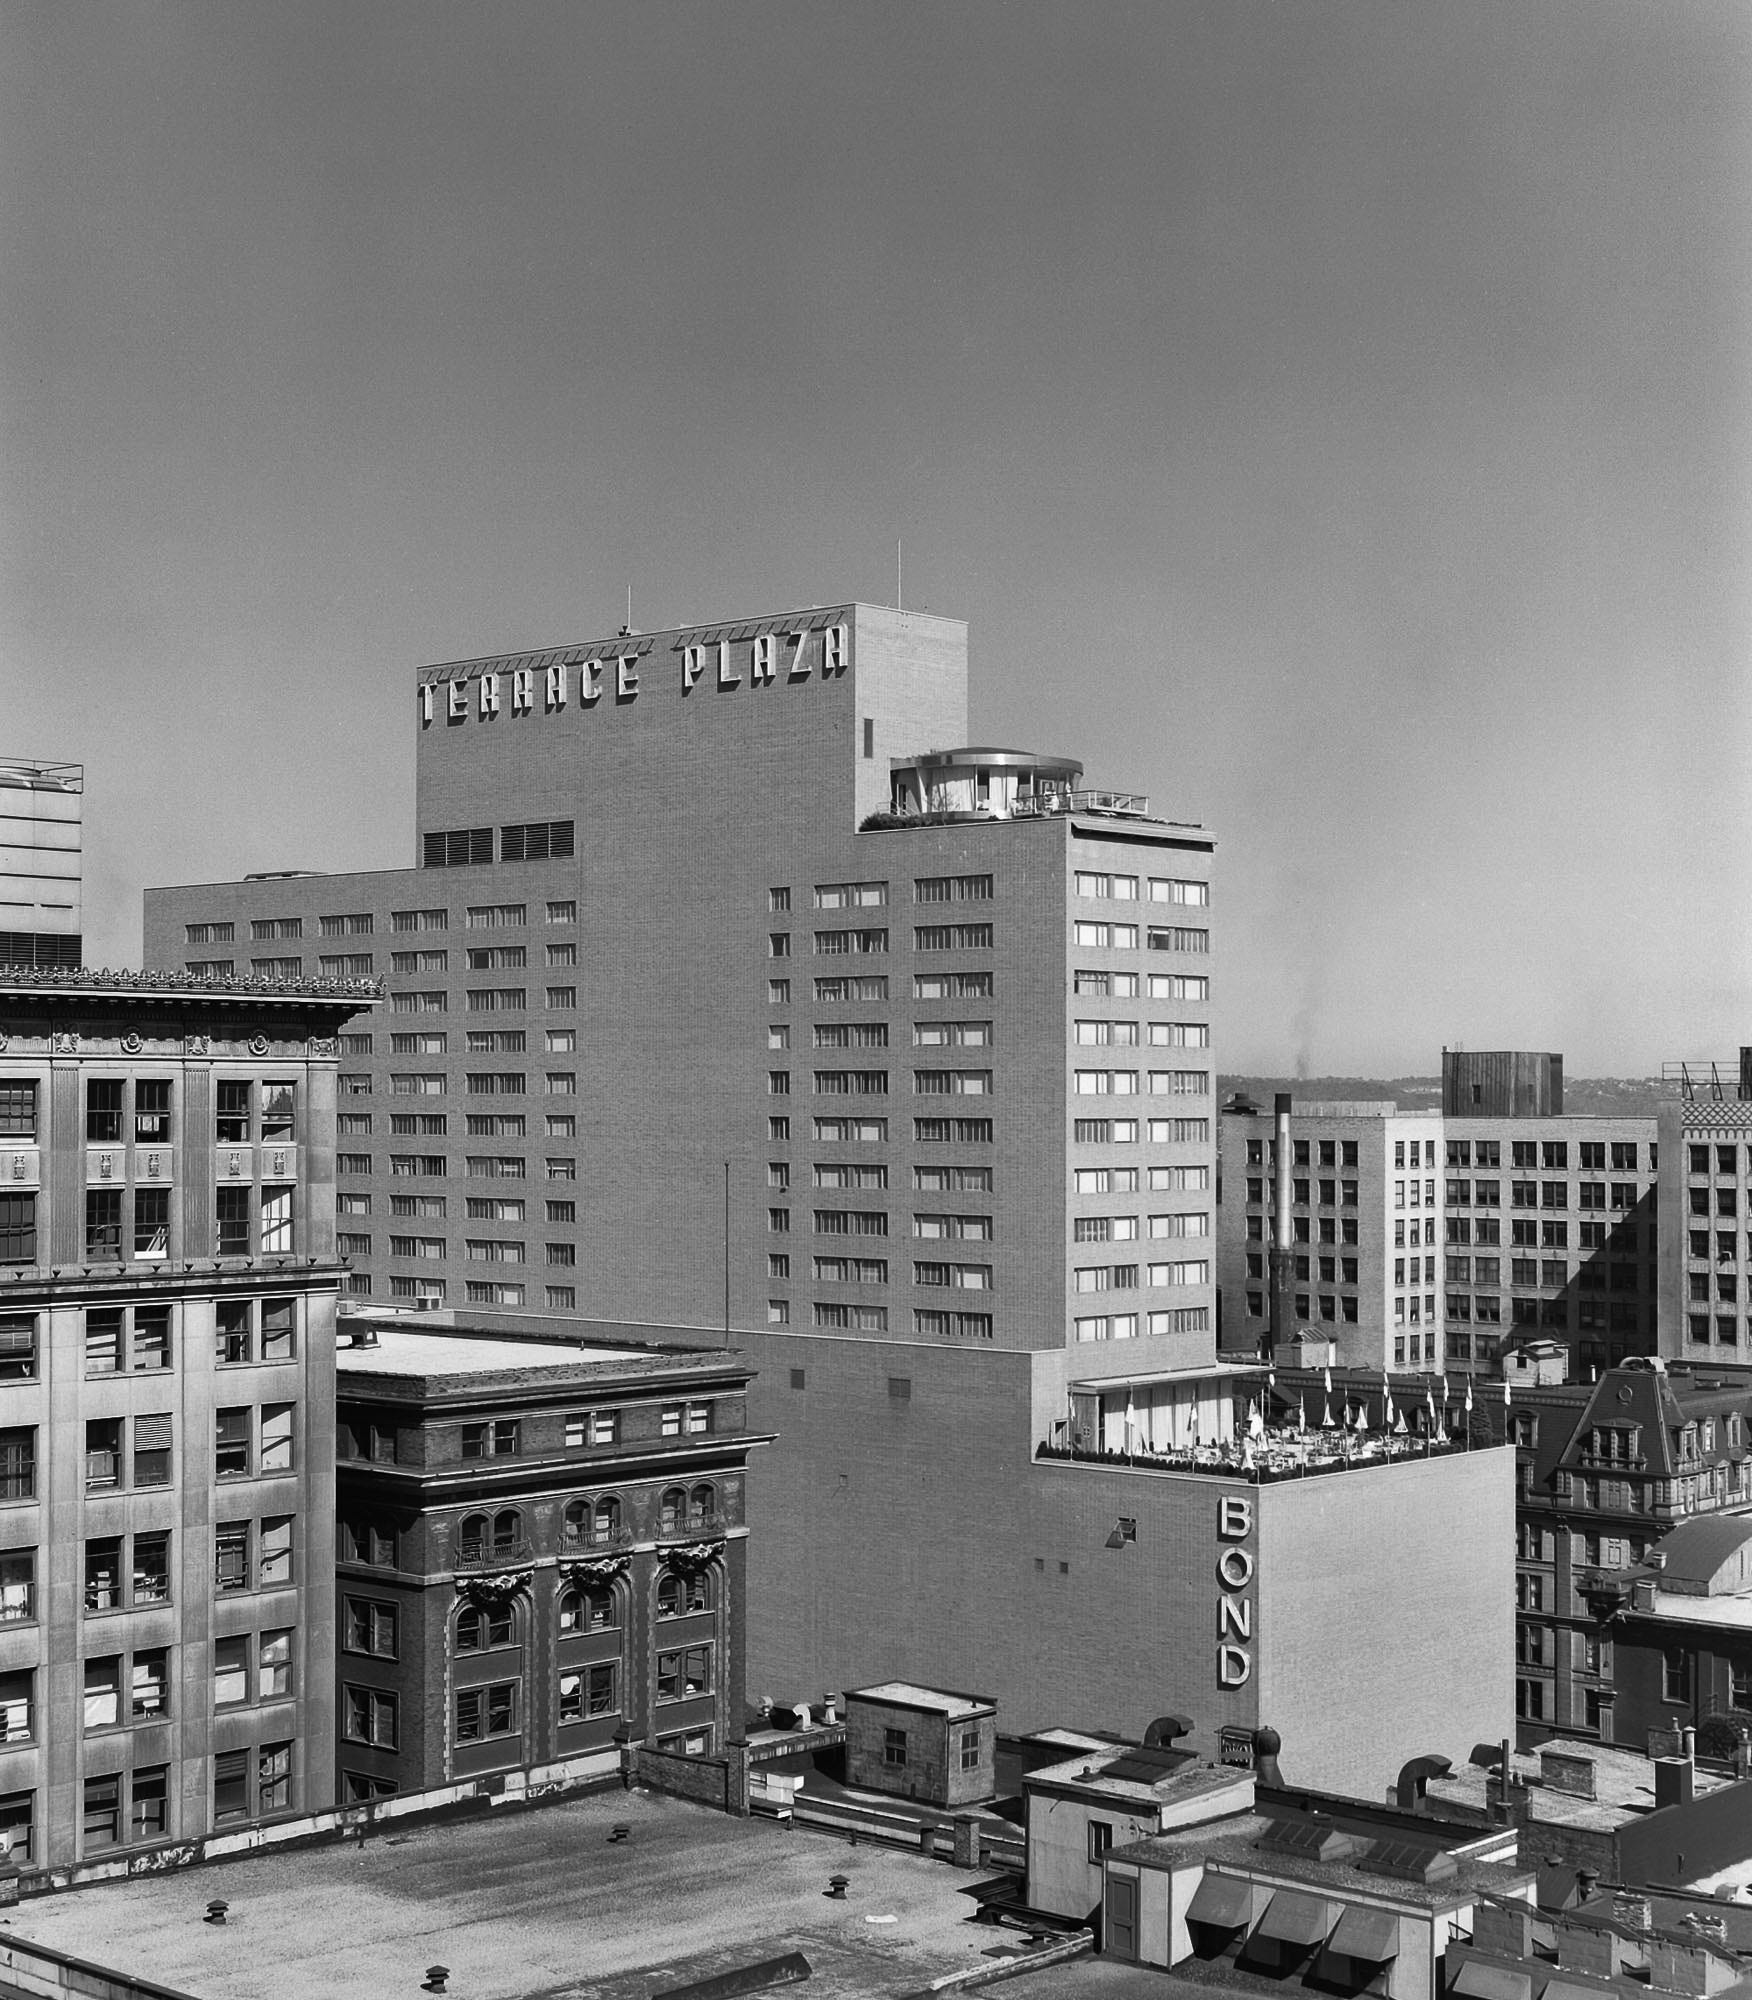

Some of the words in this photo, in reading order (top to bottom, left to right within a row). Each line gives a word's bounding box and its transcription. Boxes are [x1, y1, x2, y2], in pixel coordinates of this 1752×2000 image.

[419, 653, 639, 723] TERRACE
[683, 623, 849, 689] PLAZA
[1219, 1496, 1253, 1687] BOND
